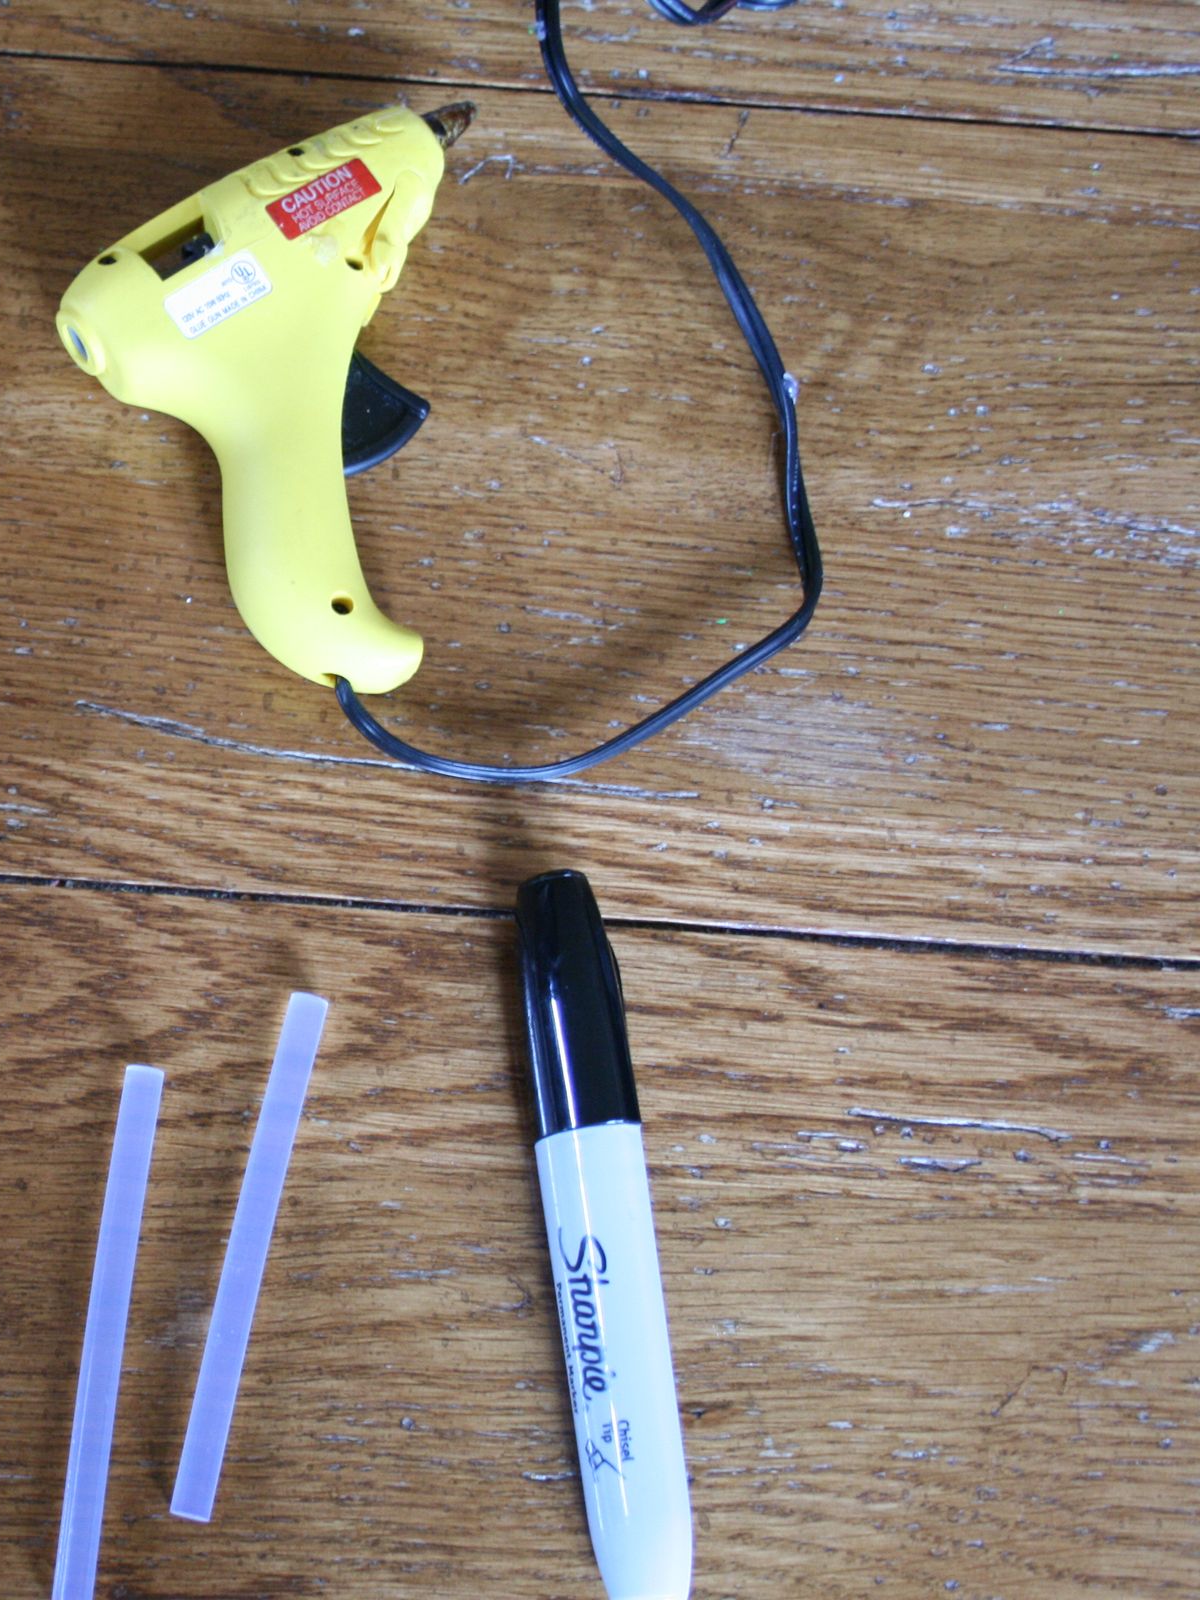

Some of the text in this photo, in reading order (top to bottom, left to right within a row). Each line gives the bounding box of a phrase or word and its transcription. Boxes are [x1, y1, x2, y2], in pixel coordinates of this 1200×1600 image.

[281, 166, 352, 213] CAUTION
[291, 179, 359, 223] HOT SURFACE
[298, 187, 365, 233] AVOID CONTACT
[208, 312, 221, 322] GUN
[223, 301, 240, 314] MADE
[558, 1227, 616, 1401] Sharpie
[555, 1283, 579, 1414] Permanent Marker
[600, 1422, 612, 1443] Tip
[617, 1420, 634, 1461] Chisel
